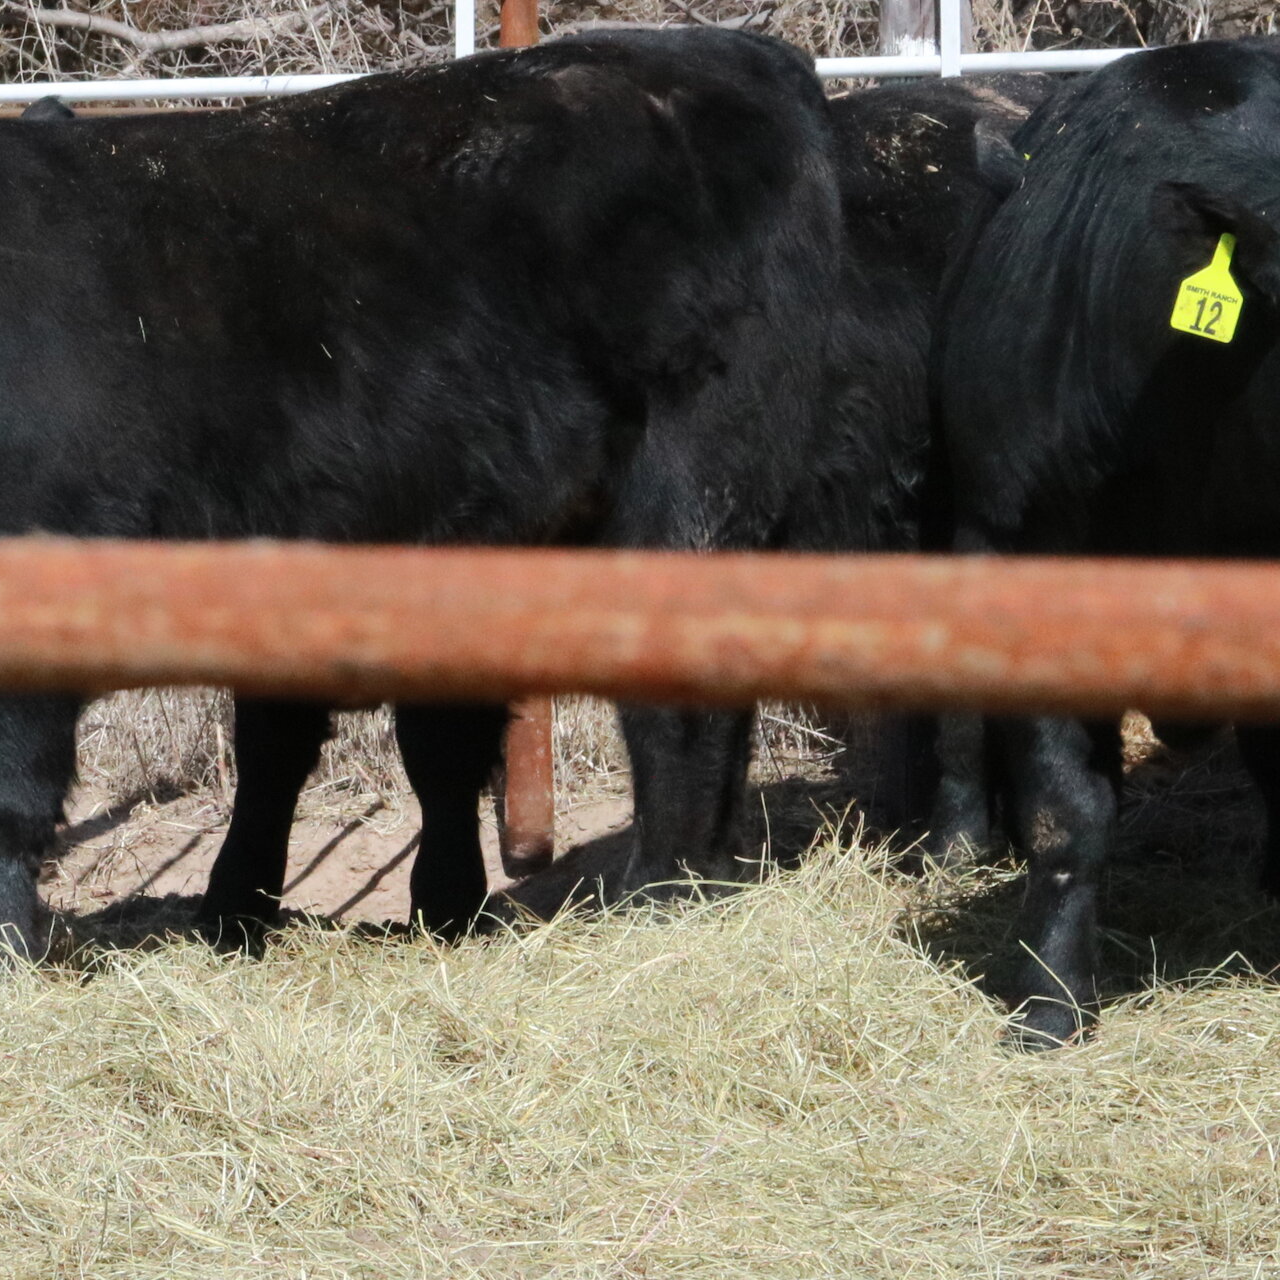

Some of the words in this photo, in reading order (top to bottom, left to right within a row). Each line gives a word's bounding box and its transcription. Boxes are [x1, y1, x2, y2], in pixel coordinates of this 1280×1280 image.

[1186, 284, 1210, 297] SMITH
[1210, 291, 1239, 305] RANCH
[1189, 296, 1224, 336] 12
